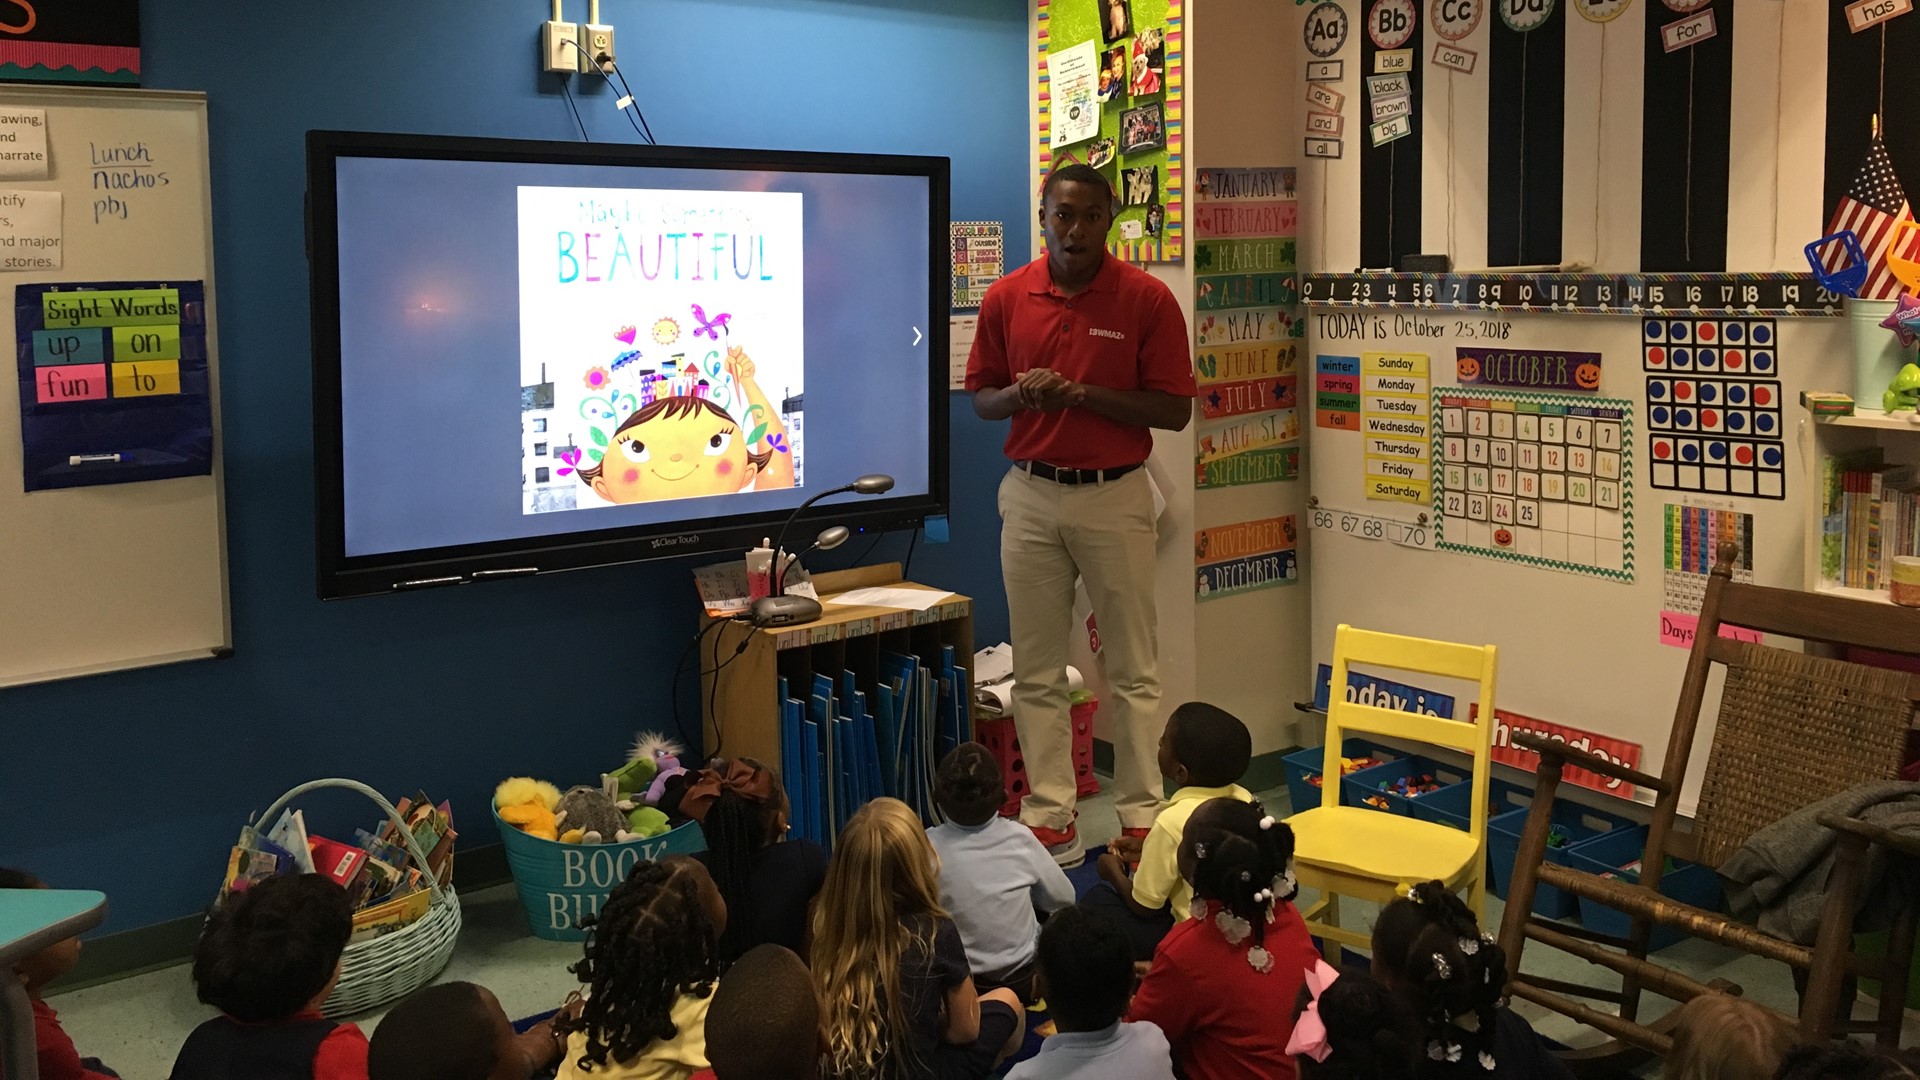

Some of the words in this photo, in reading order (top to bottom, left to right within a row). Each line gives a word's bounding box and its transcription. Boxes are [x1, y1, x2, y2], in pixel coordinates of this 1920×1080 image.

[1379, 8, 1407, 34] Bb
[1442, 0, 1472, 23] Cc
[1862, 0, 1896, 21] has
[1312, 18, 1338, 41] Aa
[1676, 22, 1702, 40] for
[1382, 56, 1404, 68] blue
[1443, 52, 1465, 66] can
[1321, 66, 1328, 75] a
[1314, 90, 1331, 104] are
[1374, 80, 1404, 93] black
[1376, 100, 1407, 116] brown
[0, 115, 42, 126] awing,
[1314, 118, 1331, 129] and
[1382, 123, 1398, 137] big
[0, 133, 16, 142] nd
[1317, 143, 1328, 154] all
[90, 142, 153, 165] Lunch
[93, 169, 169, 189] nachos
[1214, 171, 1278, 199] JANUARY
[0, 196, 25, 207] tify
[94, 196, 128, 224] pbj
[1213, 207, 1280, 235] FEBRUARY
[0, 237, 15, 246] nd
[20, 237, 60, 249] major
[5, 257, 56, 267] stories.
[558, 231, 772, 283] BEAUTIFUL
[1218, 243, 1274, 271] MARCH
[1221, 278, 1275, 306] APRIL
[1304, 283, 1312, 295] 0
[1330, 283, 1334, 296] 1
[1352, 283, 1359, 296] 2
[1363, 283, 1371, 296] 3
[1388, 284, 1396, 297] 4
[1413, 283, 1421, 296] 5
[1424, 283, 1433, 297] 6
[1452, 284, 1460, 297] 7
[1479, 284, 1487, 298] 8
[1491, 284, 1501, 299] 9
[1519, 286, 1532, 299] 10
[1551, 285, 1558, 299] 11
[1565, 285, 1578, 300] 12
[1598, 286, 1612, 301] 13
[1629, 286, 1642, 301] 14
[1649, 286, 1664, 301] 15
[1686, 286, 1702, 302] 16
[1721, 286, 1734, 301] 17
[1743, 286, 1759, 302] 18
[1782, 285, 1799, 302] 19
[1816, 286, 1840, 302] 20
[48, 299, 102, 326] Sight
[110, 297, 178, 317] Words
[1227, 312, 1265, 342] MAY
[1317, 313, 1368, 339] TODAY
[1374, 314, 1387, 339] is
[1394, 314, 1448, 338] October
[48, 336, 80, 362] up
[131, 334, 161, 353] on
[1223, 348, 1268, 377] JUNE
[1322, 361, 1353, 372] winter
[1378, 357, 1413, 372] Sunday
[1485, 354, 1568, 385] OCTOBER
[42, 371, 89, 397] fun
[128, 364, 156, 391] to
[1323, 380, 1352, 392] spring
[1378, 378, 1415, 393] Monday
[1225, 382, 1267, 413] JULY
[1319, 398, 1357, 409] summer
[1376, 399, 1417, 413] Tuesday
[1329, 414, 1346, 425] fall
[1369, 420, 1425, 436] Wednesday
[1450, 414, 1454, 428] 1
[1475, 417, 1481, 431] 2
[1499, 419, 1505, 433] 3
[1524, 420, 1530, 435] 4
[1549, 423, 1554, 438] 5
[1576, 425, 1582, 440] 6
[1604, 429, 1610, 443] 7
[1221, 414, 1277, 454] AUGUST
[1375, 441, 1420, 457] Thursday
[1451, 443, 1456, 457] 8
[1475, 444, 1480, 458] 9
[1496, 447, 1506, 462] 10
[1523, 450, 1532, 464] 11
[1547, 451, 1558, 466] 12
[1574, 453, 1585, 467] 13
[1602, 458, 1612, 473] 14
[1211, 453, 1282, 484] SEPTEMBER
[1382, 463, 1414, 478] Friday
[1376, 484, 1420, 500] Saturday
[1450, 470, 1459, 485] 15
[1473, 473, 1483, 487] 16
[1497, 474, 1506, 488] 17
[1523, 478, 1532, 493] 18
[1548, 479, 1558, 494] 19
[1573, 482, 1585, 497] 20
[1601, 487, 1612, 502] 21
[1449, 497, 1460, 511] 22
[1472, 500, 1482, 515] 23
[1496, 504, 1508, 519] 24
[1522, 506, 1533, 521] 25
[1210, 521, 1282, 557] NOVEMBER
[1314, 512, 1333, 529] 66
[1341, 516, 1359, 532] 67
[1363, 520, 1383, 537] 68
[1404, 526, 1425, 545] 70
[1215, 556, 1280, 594] DECEMBER
[1662, 617, 1693, 643] Days
[1327, 680, 1407, 711] oday
